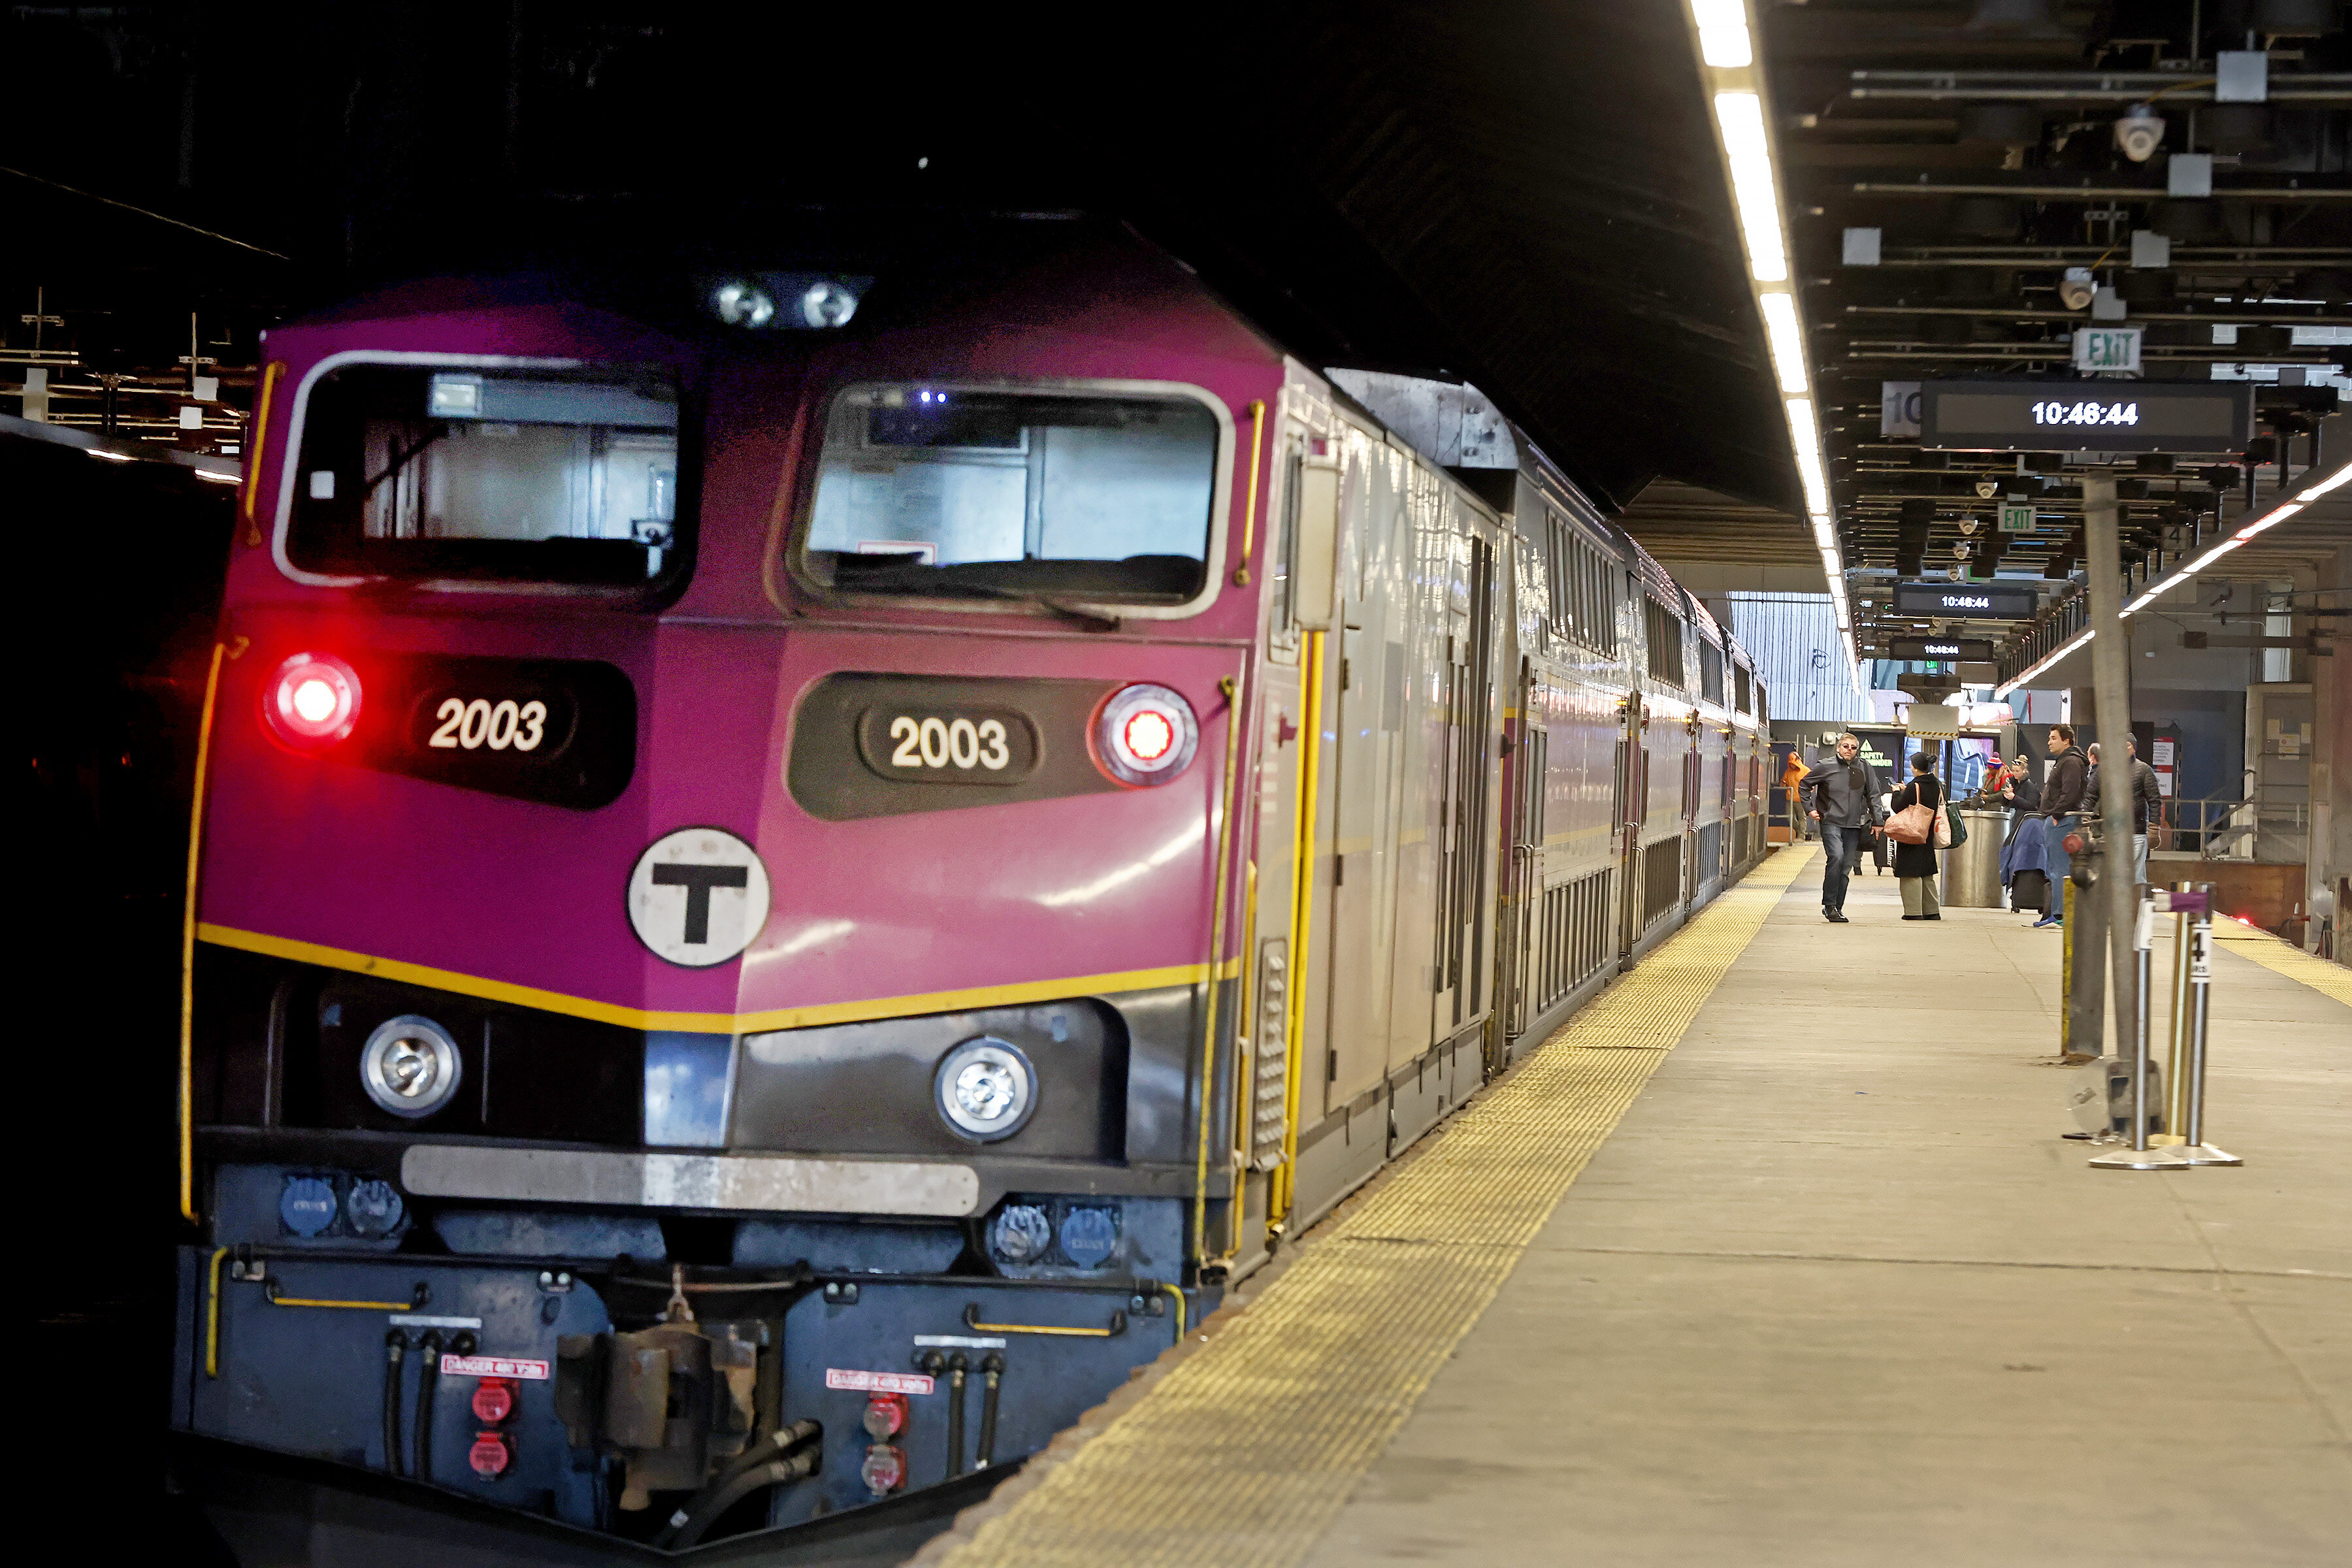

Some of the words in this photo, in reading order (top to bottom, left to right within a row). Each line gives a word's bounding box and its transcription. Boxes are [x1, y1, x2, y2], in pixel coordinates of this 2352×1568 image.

[2089, 333, 2133, 366] EXIT
[2032, 402, 2138, 426] 10:46:44
[2004, 509, 2032, 529] EXIT
[1941, 596, 1989, 608] 10:46:44
[429, 698, 547, 751] 2003
[890, 716, 1009, 770] 2003
[652, 863, 748, 944] T
